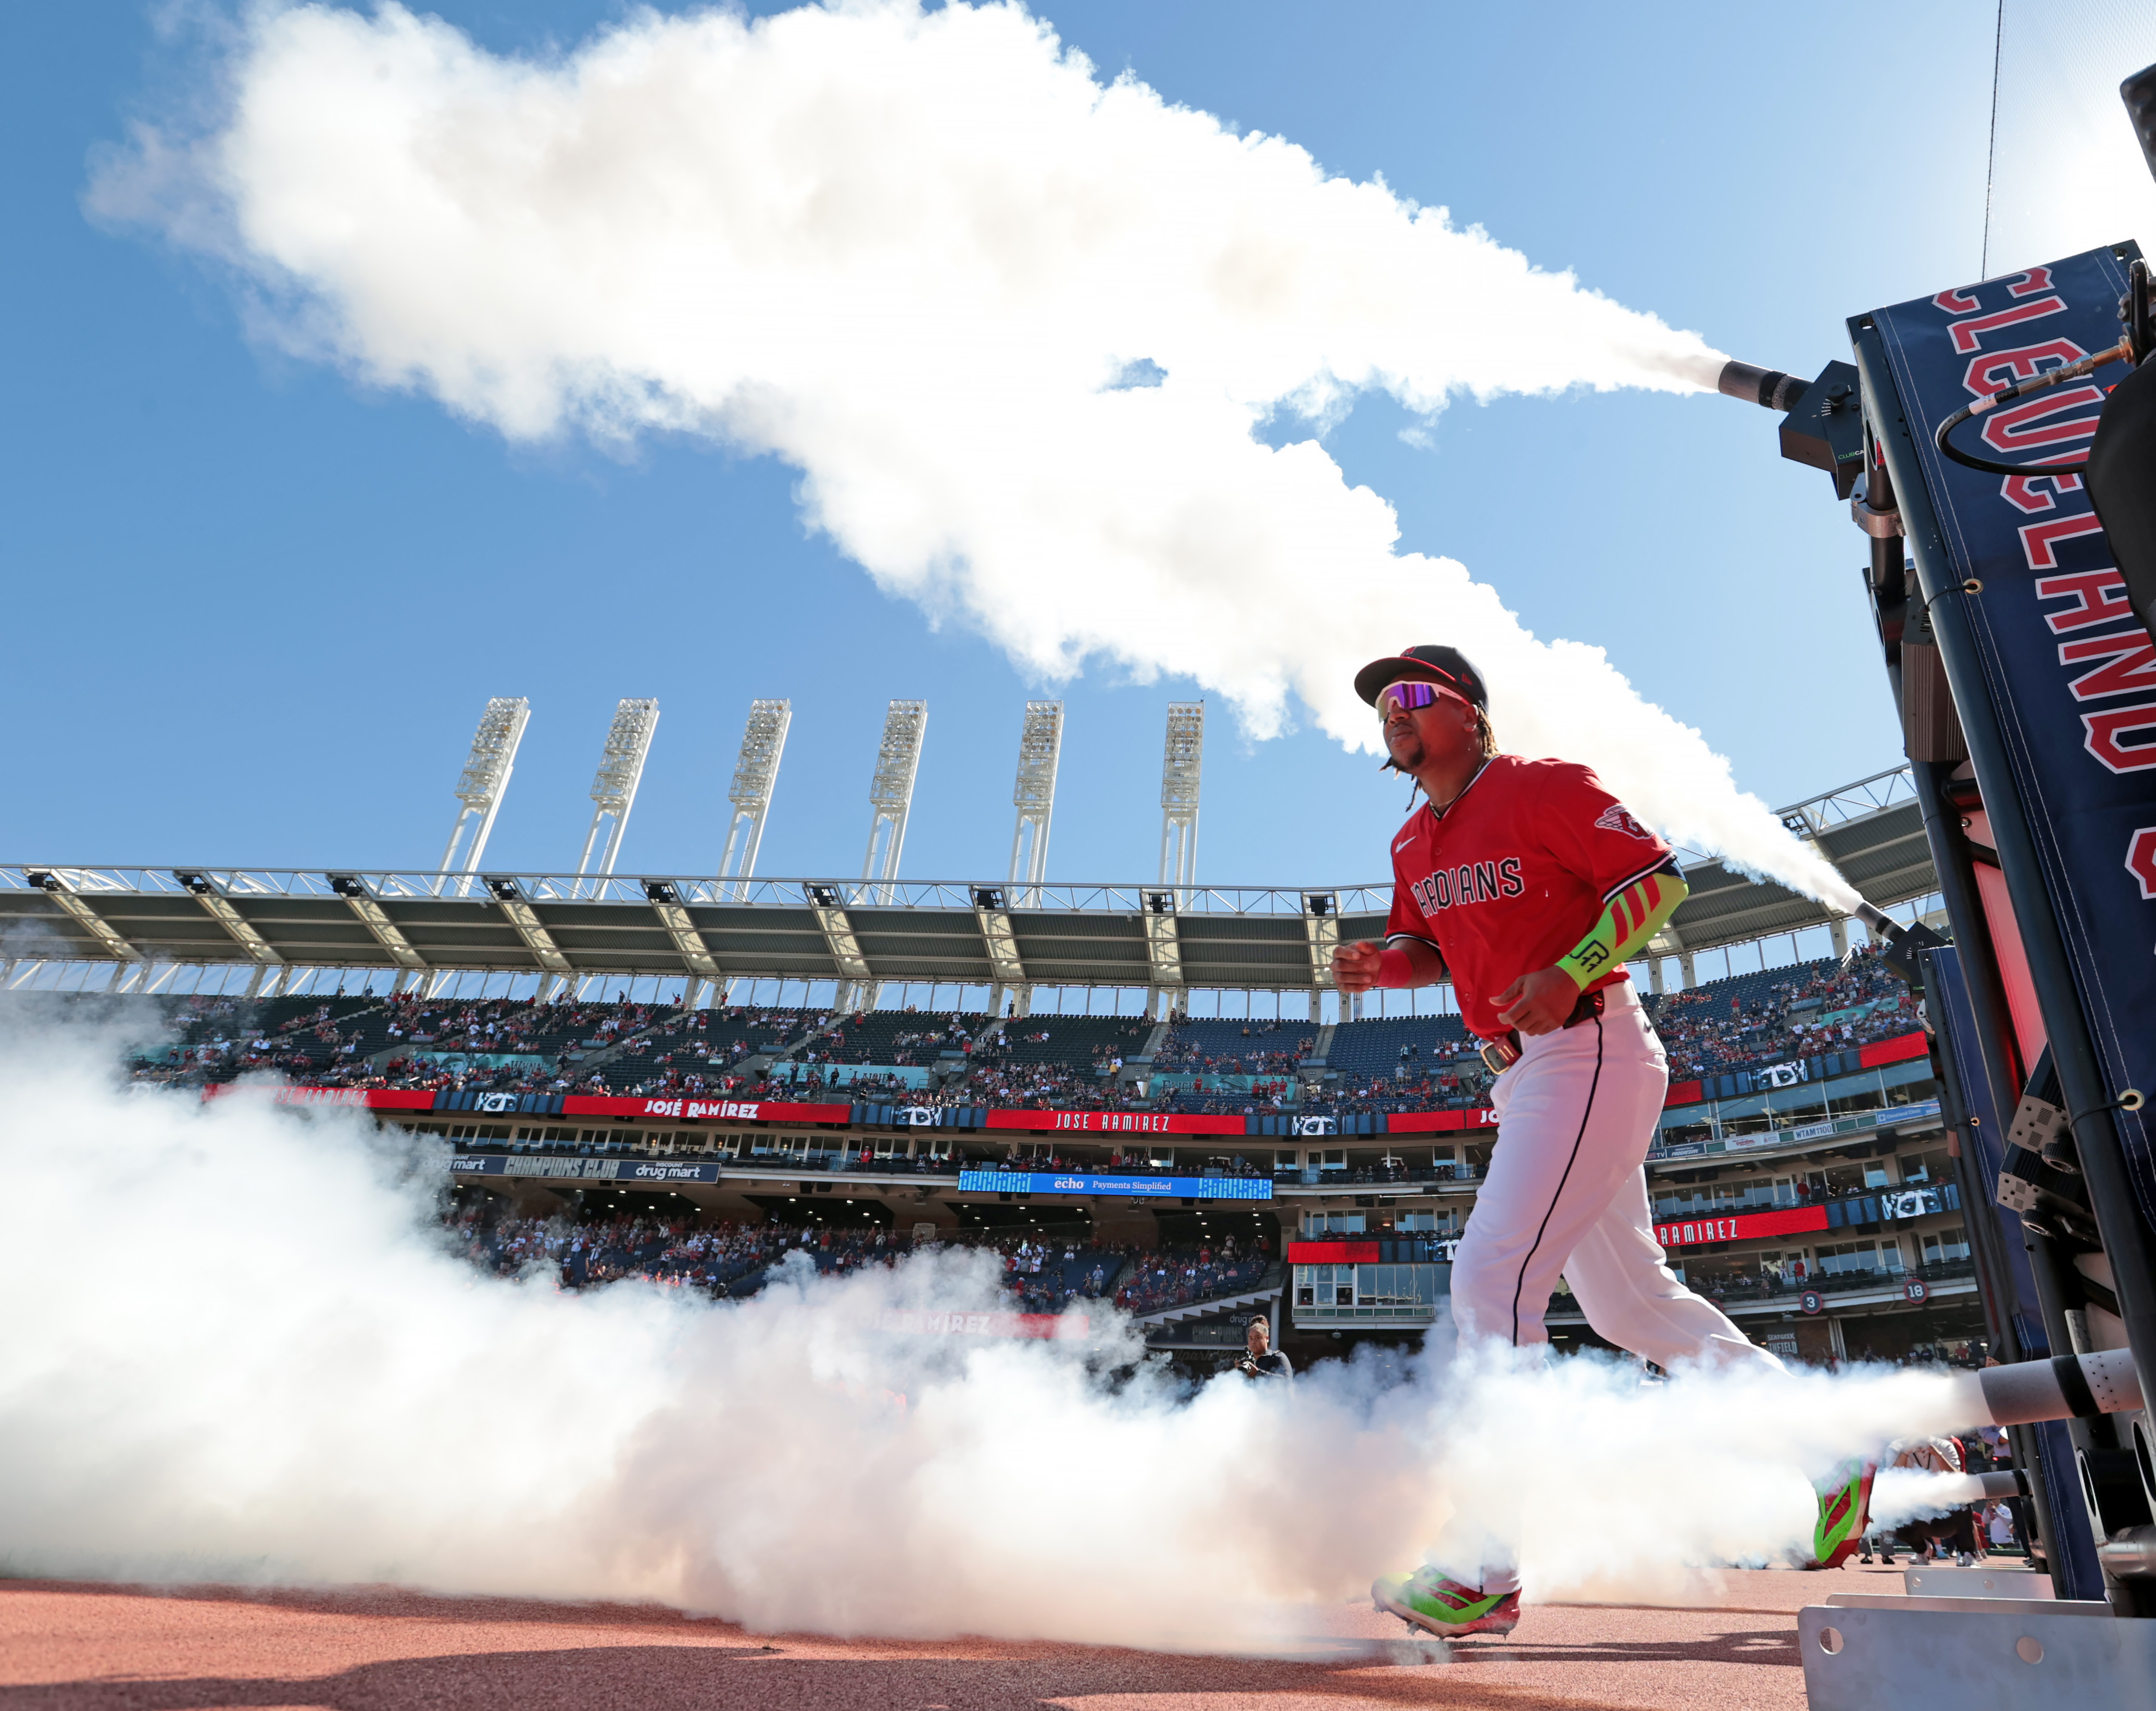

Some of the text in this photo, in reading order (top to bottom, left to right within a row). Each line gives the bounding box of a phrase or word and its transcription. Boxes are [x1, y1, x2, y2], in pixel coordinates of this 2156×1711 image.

[1411, 857, 1525, 918] ARDIANS
[644, 1098, 759, 1119] JOSÉ RAMÍREZ
[453, 1158, 486, 1170] mart
[503, 1156, 620, 1179] CHAMPIONS CLUB
[635, 1165, 700, 1180] drug mart
[1055, 1177, 1171, 1191] echo Payments Simplified
[1908, 1284, 1923, 1297] 18
[1807, 1296, 1815, 1308] 3
[1230, 1314, 1249, 1326] drug
[1193, 1326, 1243, 1343] CHAMPIONS
[1767, 1333, 1796, 1341] SEATGEEK
[1769, 1341, 1798, 1354] INFIELD
